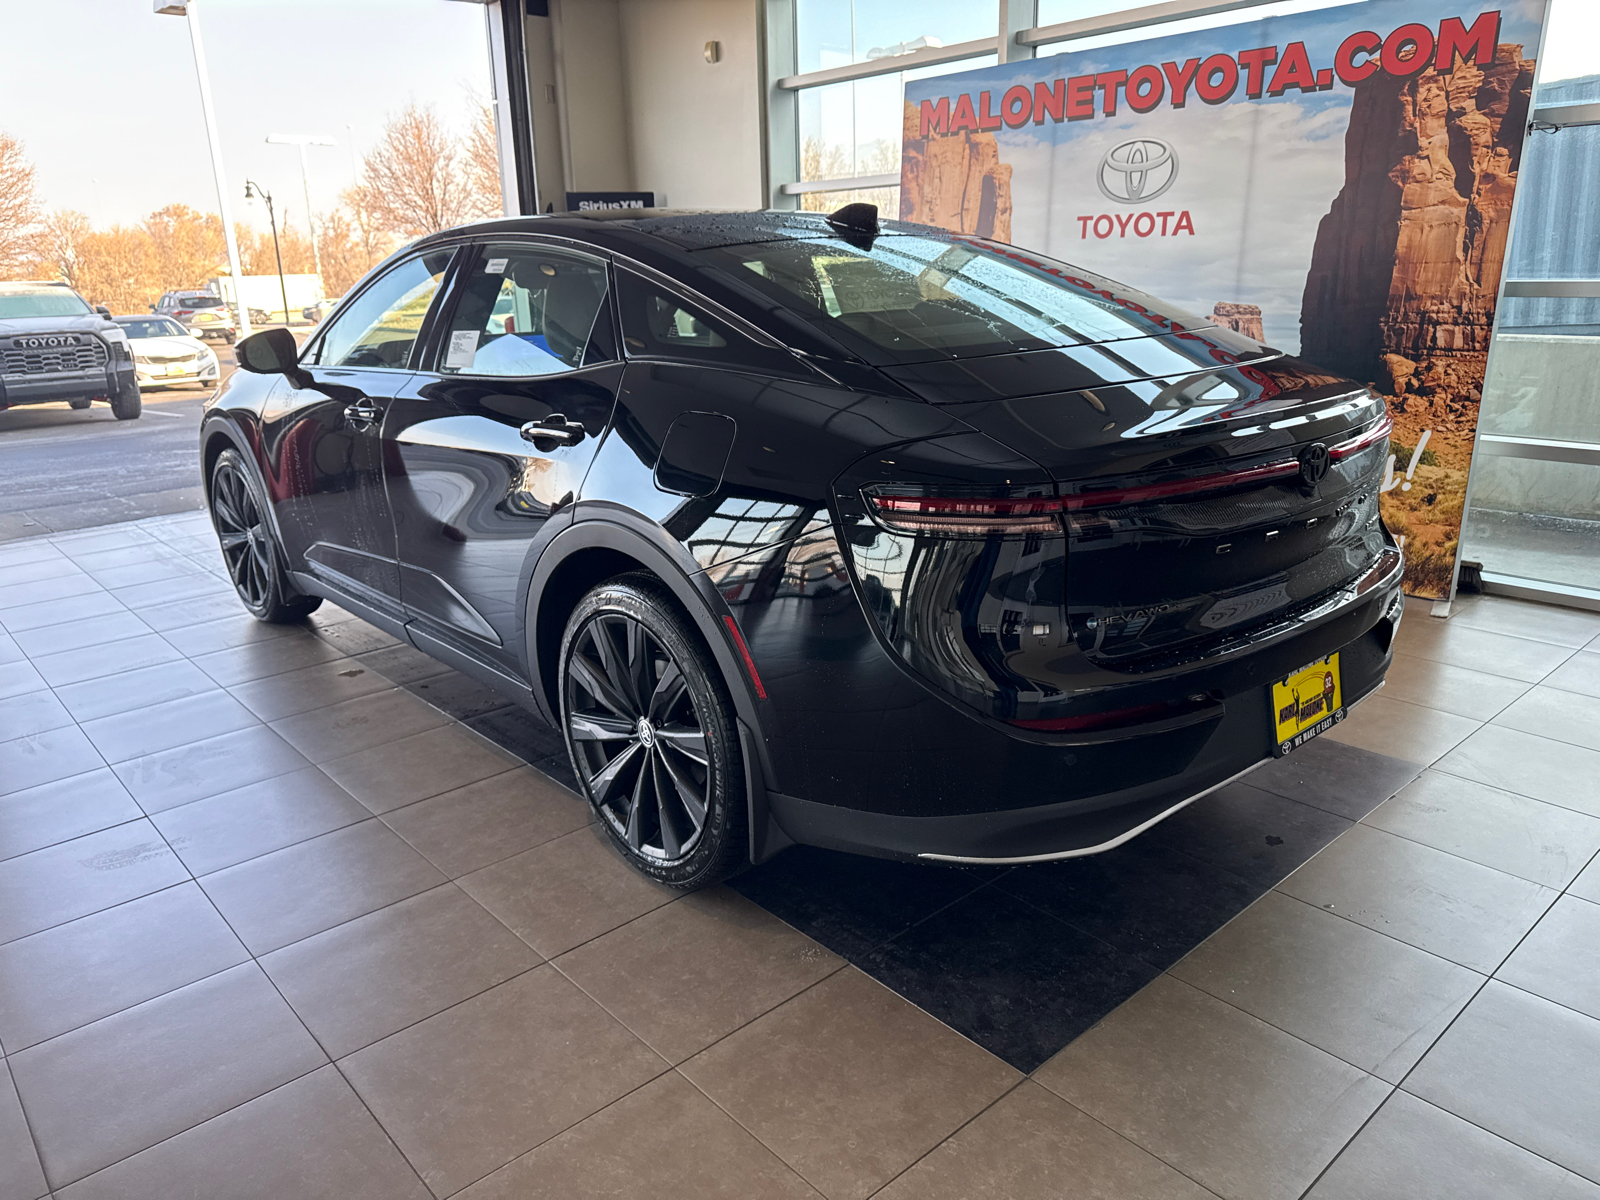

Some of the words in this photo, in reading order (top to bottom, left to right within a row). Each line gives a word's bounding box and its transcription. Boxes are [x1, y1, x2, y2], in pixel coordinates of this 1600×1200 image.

[919, 10, 1501, 137] MALONETOYOTA.COM
[579, 200, 644, 212] SiriusXM
[1077, 210, 1195, 239] TOYOTA
[19, 336, 76, 348] TOYOTA
[1325, 676, 1332, 688] 32
[1294, 735, 1303, 747] WE
[1302, 727, 1316, 742] MAKE
[1316, 724, 1321, 734] IT
[1321, 717, 1333, 731] EASY
